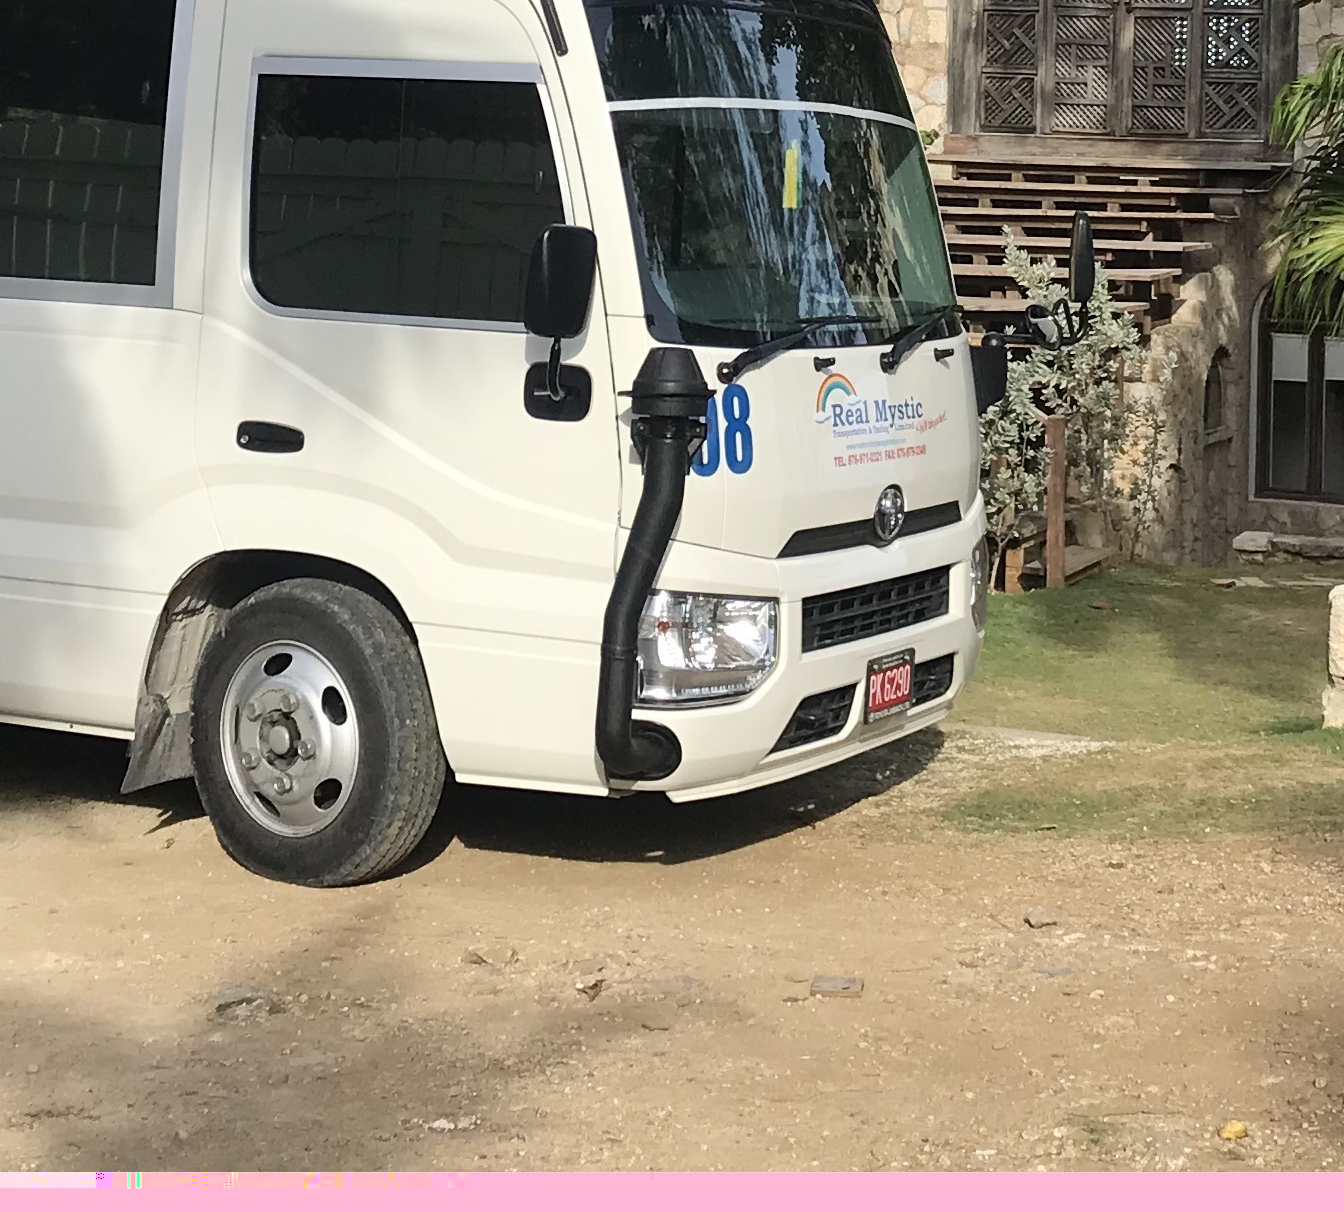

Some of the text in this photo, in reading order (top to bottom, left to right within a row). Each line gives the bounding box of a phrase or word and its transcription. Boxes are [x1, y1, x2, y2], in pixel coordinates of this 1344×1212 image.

[831, 400, 870, 427] Real
[873, 396, 923, 428] Mystic
[869, 664, 911, 707] PK 6290
